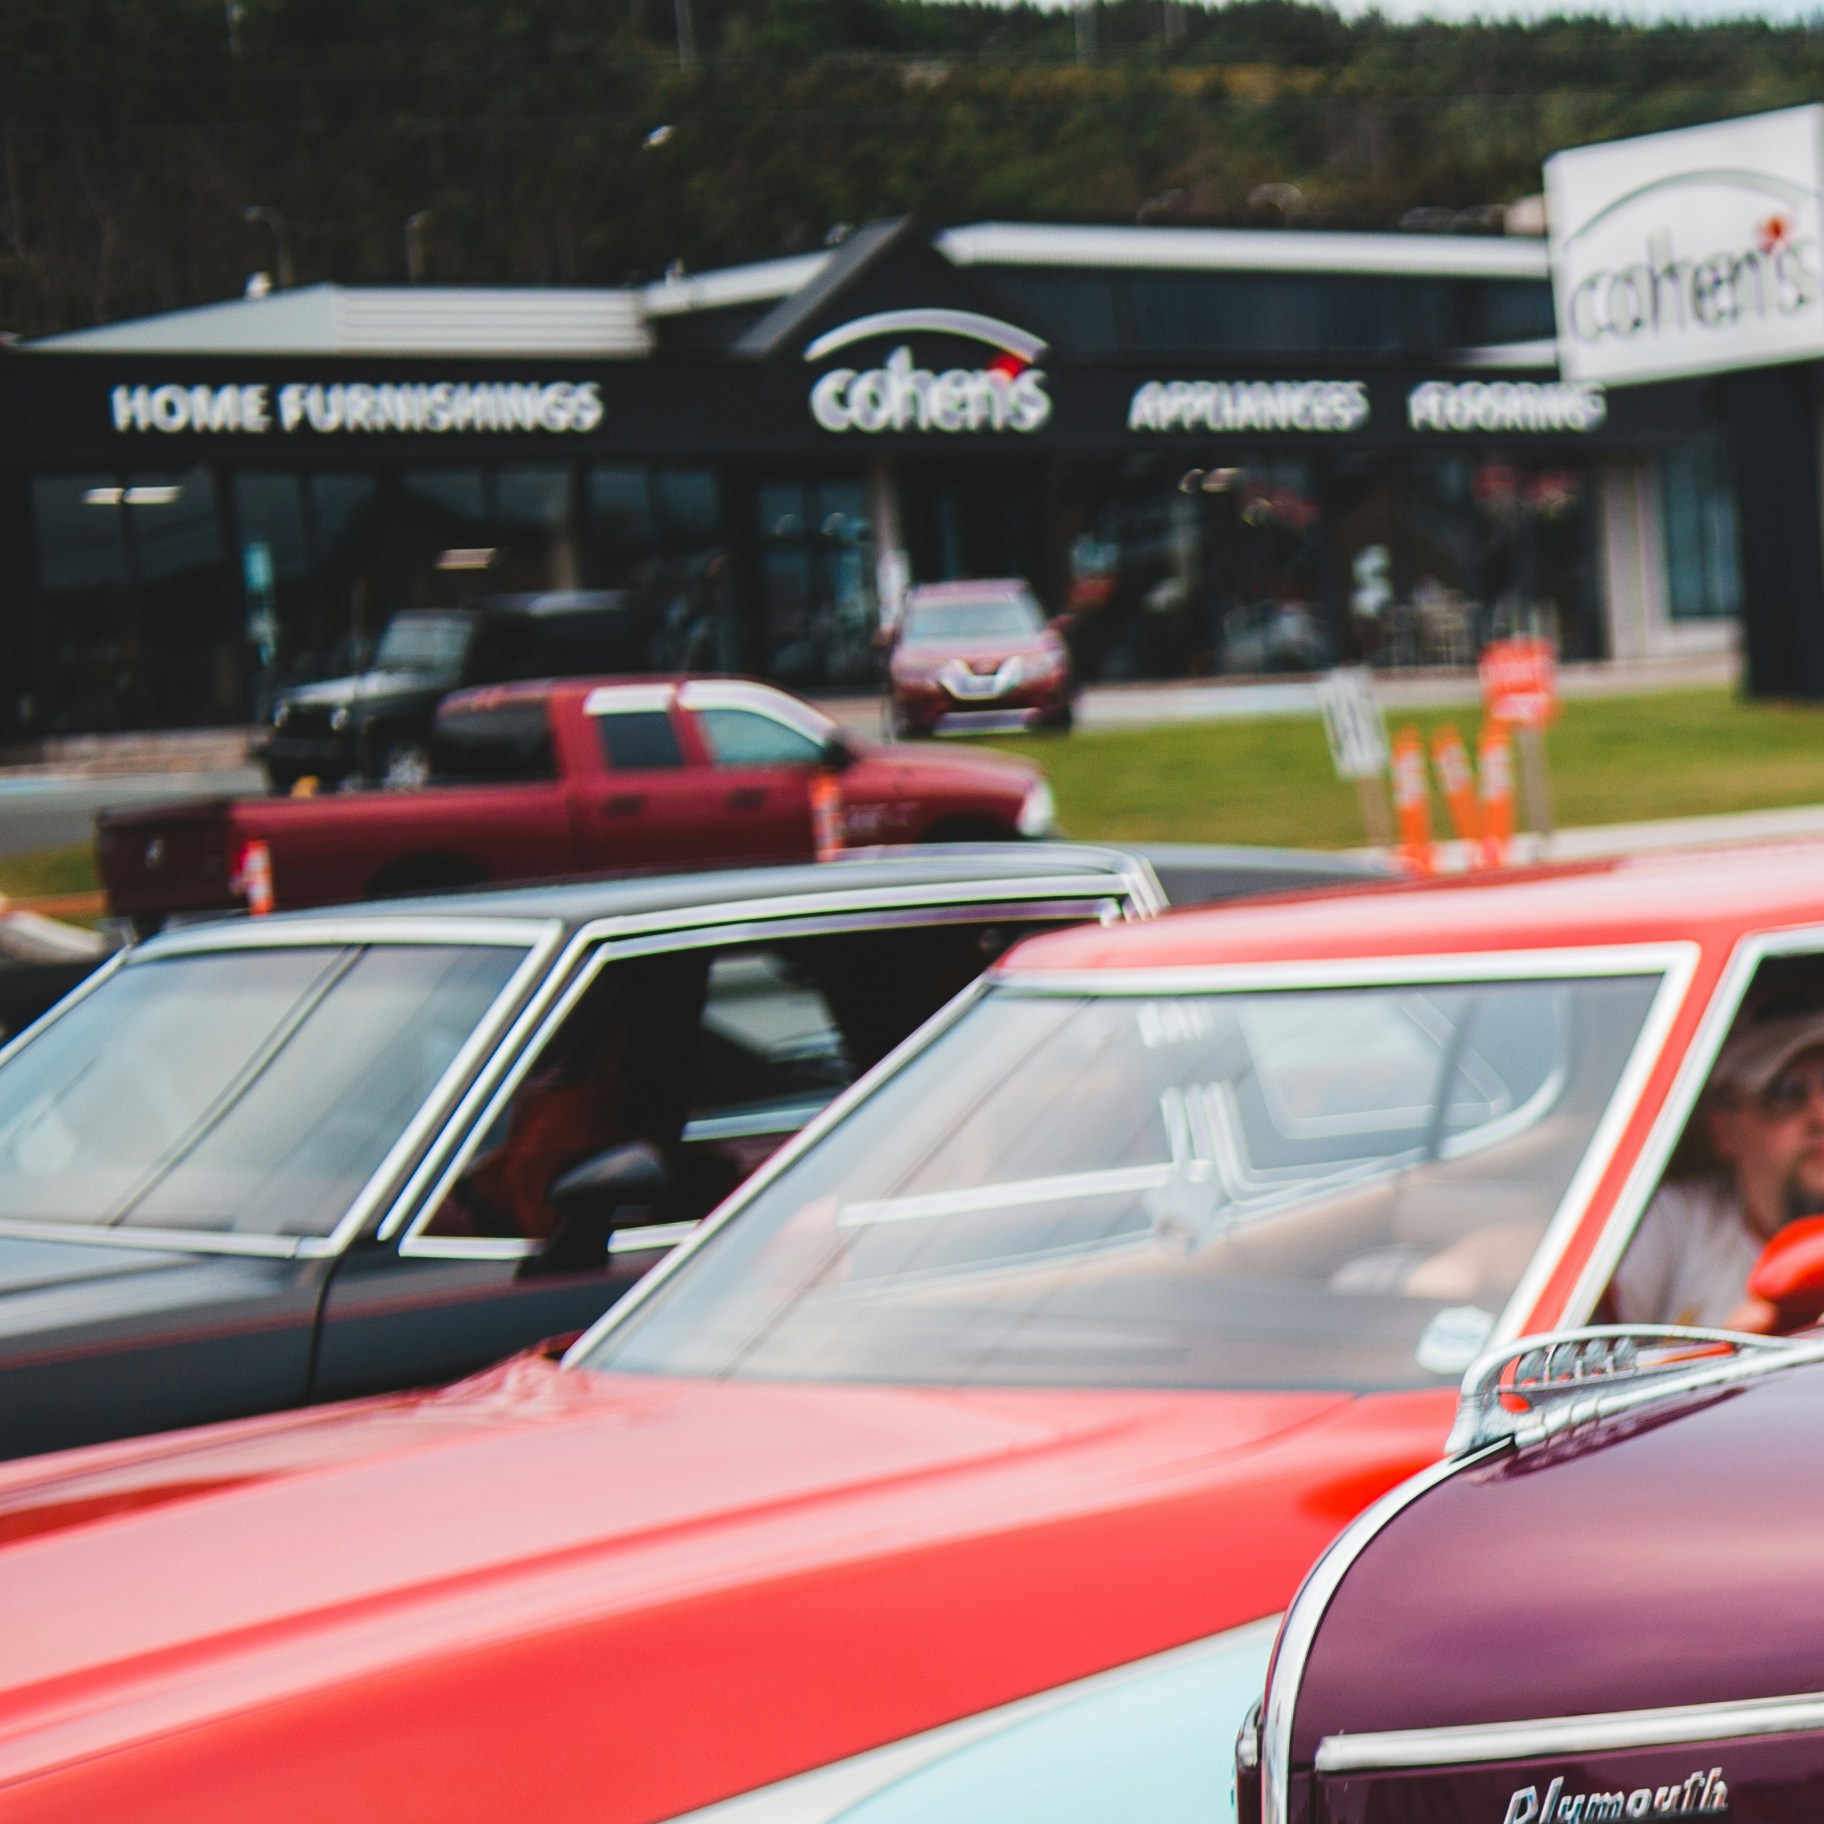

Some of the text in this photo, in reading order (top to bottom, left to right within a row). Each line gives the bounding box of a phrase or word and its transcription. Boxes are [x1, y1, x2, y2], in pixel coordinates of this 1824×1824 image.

[110, 380, 604, 433] HOME FURNISHINGS
[1127, 380, 1370, 432] APPLIANCES
[1407, 380, 1606, 433] FLOORING
